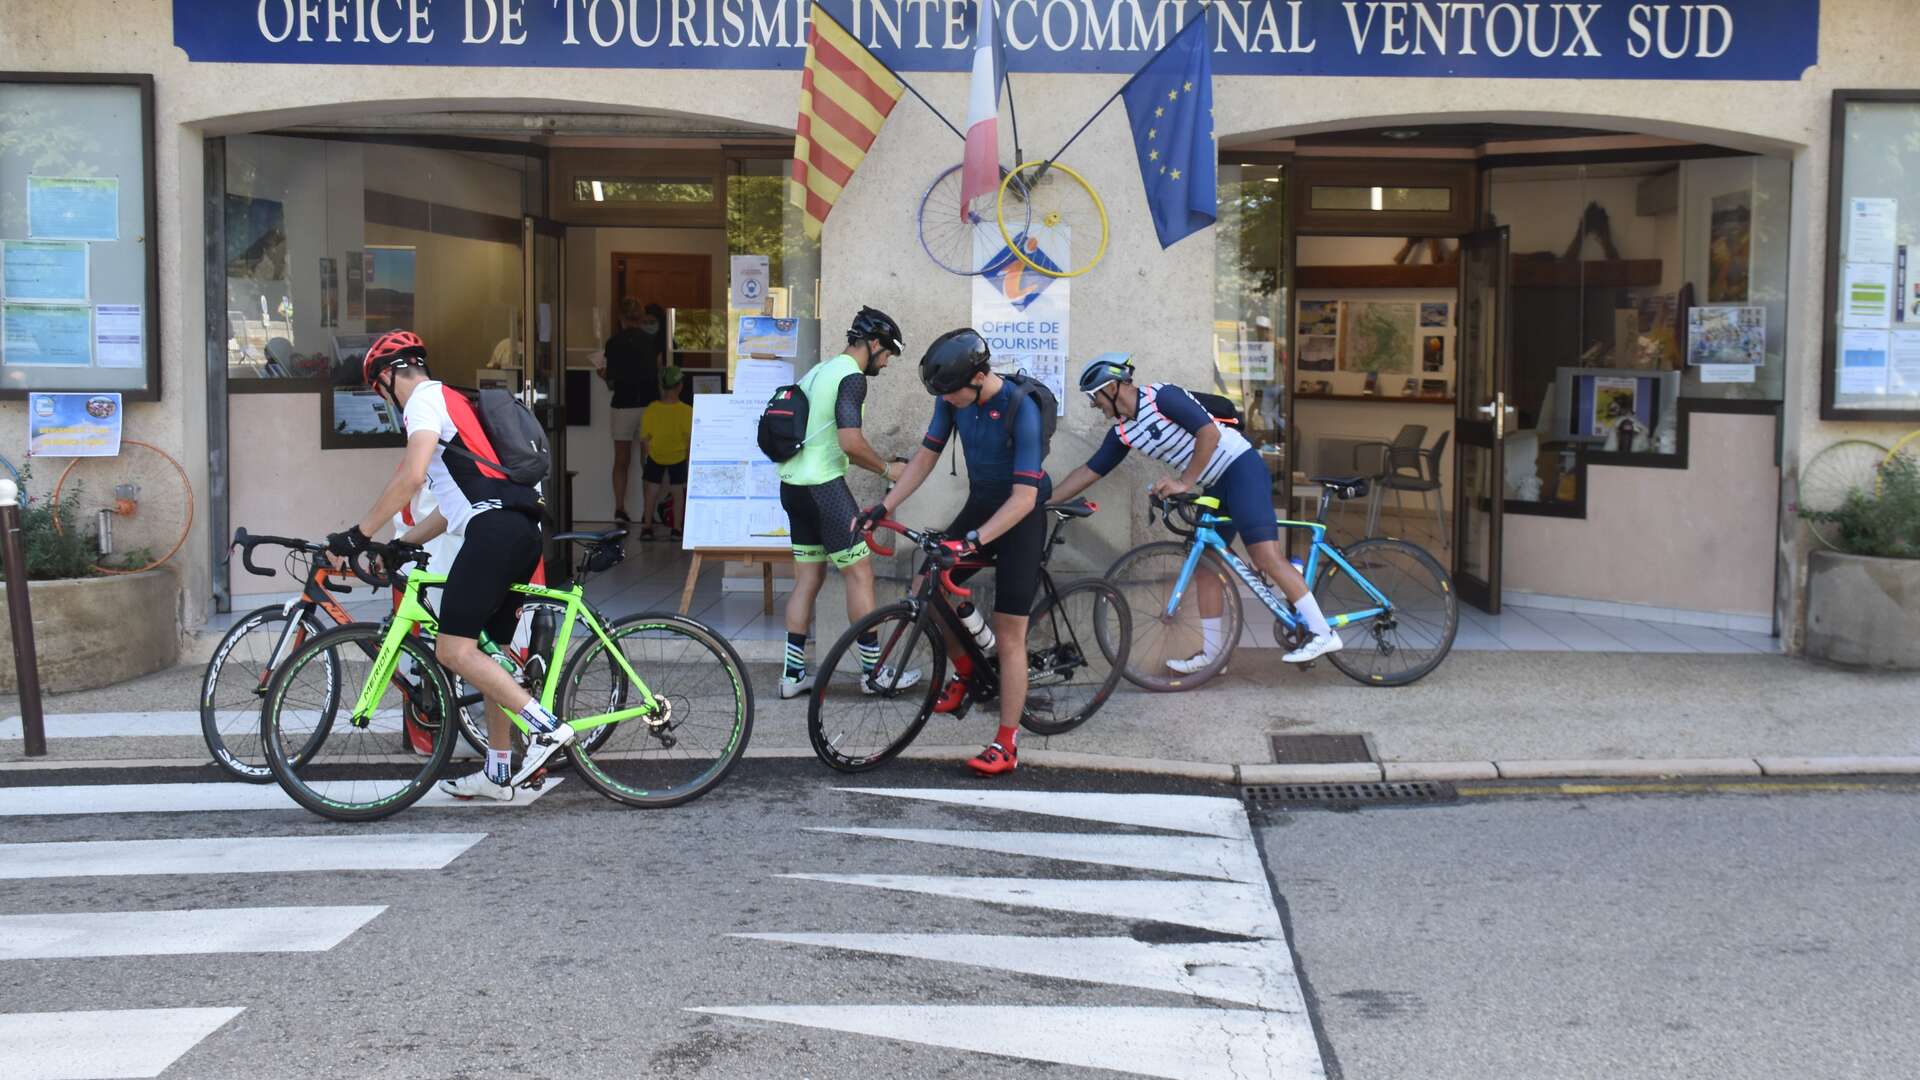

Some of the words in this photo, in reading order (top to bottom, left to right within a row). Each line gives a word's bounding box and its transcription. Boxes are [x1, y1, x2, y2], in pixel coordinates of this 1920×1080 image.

[257, 0, 435, 44] OFFICE
[461, 0, 528, 45] DE
[851, 0, 1316, 54] INTECOMMNAL
[1342, 1, 1602, 57] VENTOUX
[1627, 3, 1734, 59] SUD
[982, 321, 1034, 333] OFFICE
[1040, 321, 1060, 333] DE
[985, 337, 1059, 350] TOURISME
